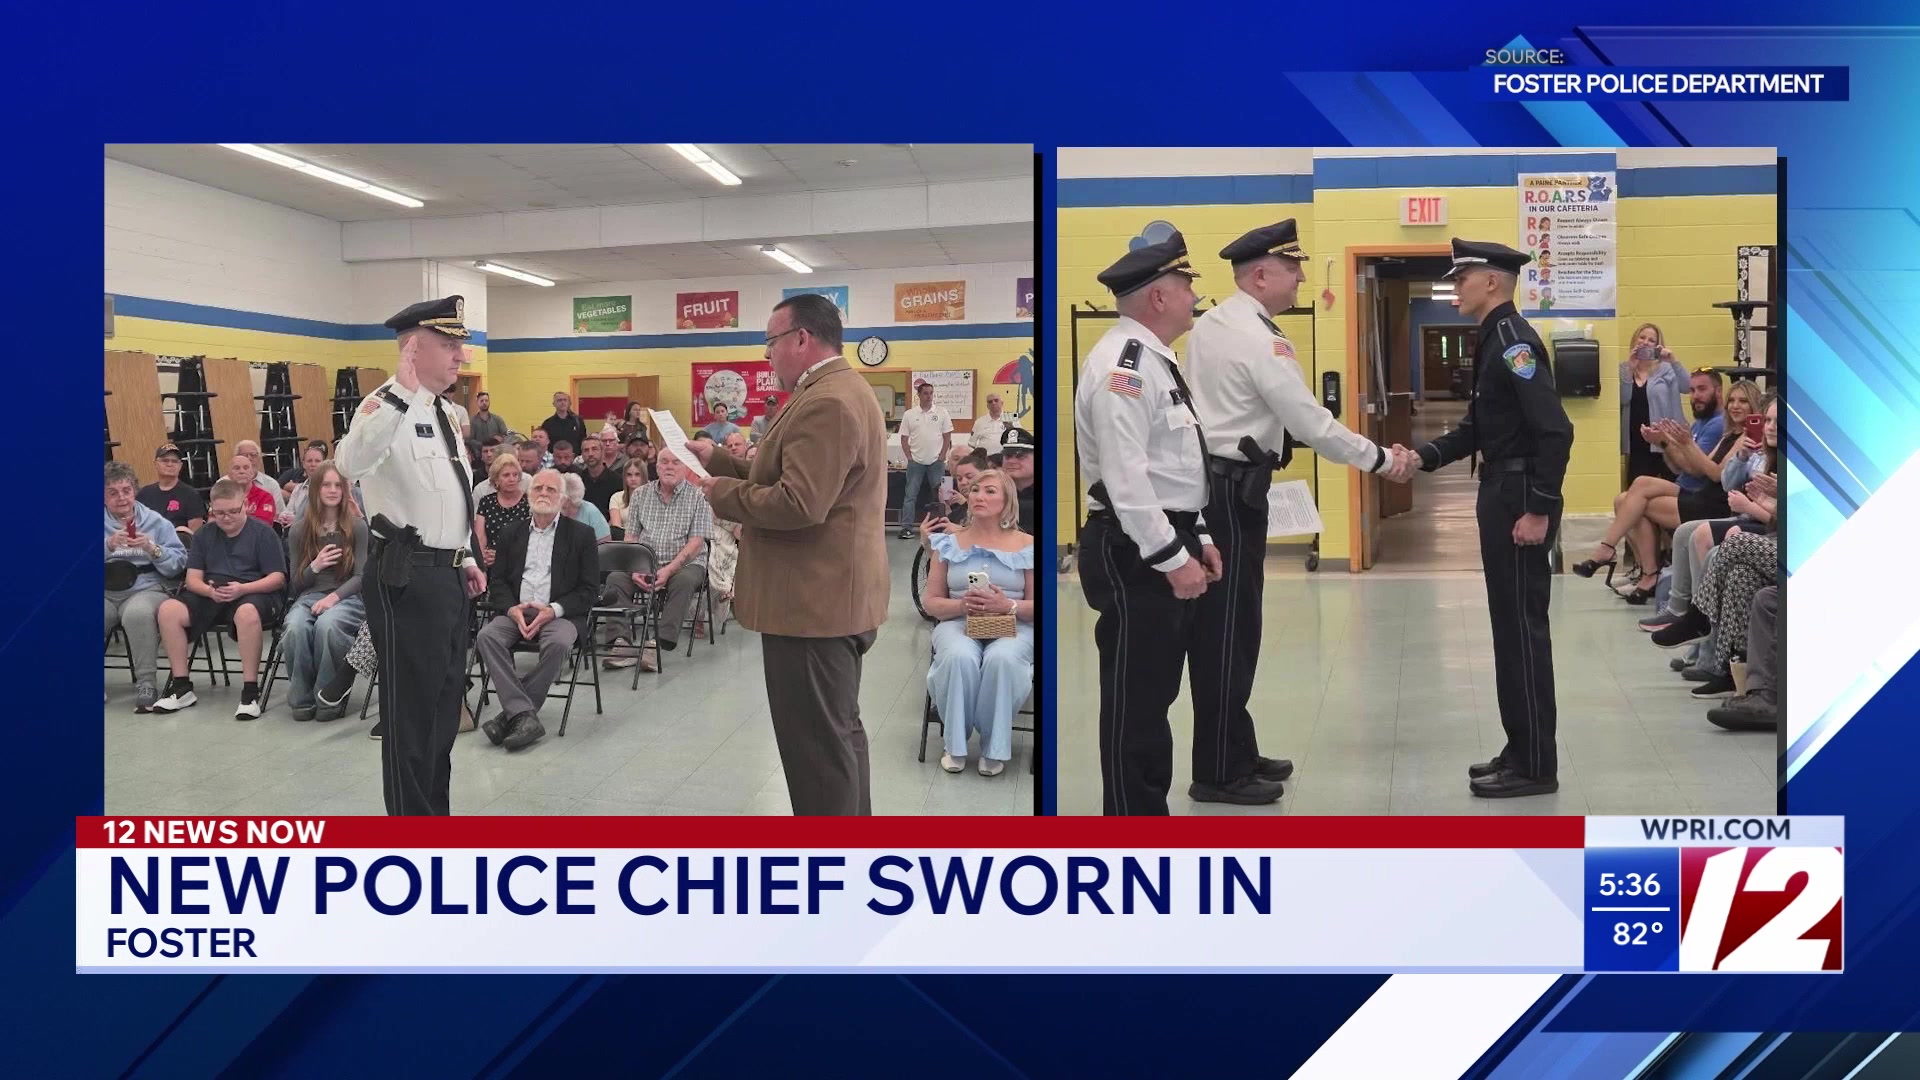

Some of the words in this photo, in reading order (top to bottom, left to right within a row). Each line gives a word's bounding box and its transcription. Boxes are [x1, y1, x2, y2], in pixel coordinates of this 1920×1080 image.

[1408, 197, 1441, 222] EXIT
[1527, 217, 1536, 229] R
[1527, 234, 1537, 246] O
[1529, 250, 1537, 261] A
[1529, 269, 1537, 281] R
[901, 288, 959, 308] GRAINS
[1529, 289, 1537, 300] S
[577, 304, 627, 319] VEGETABLES
[683, 298, 730, 318] FRUIT
